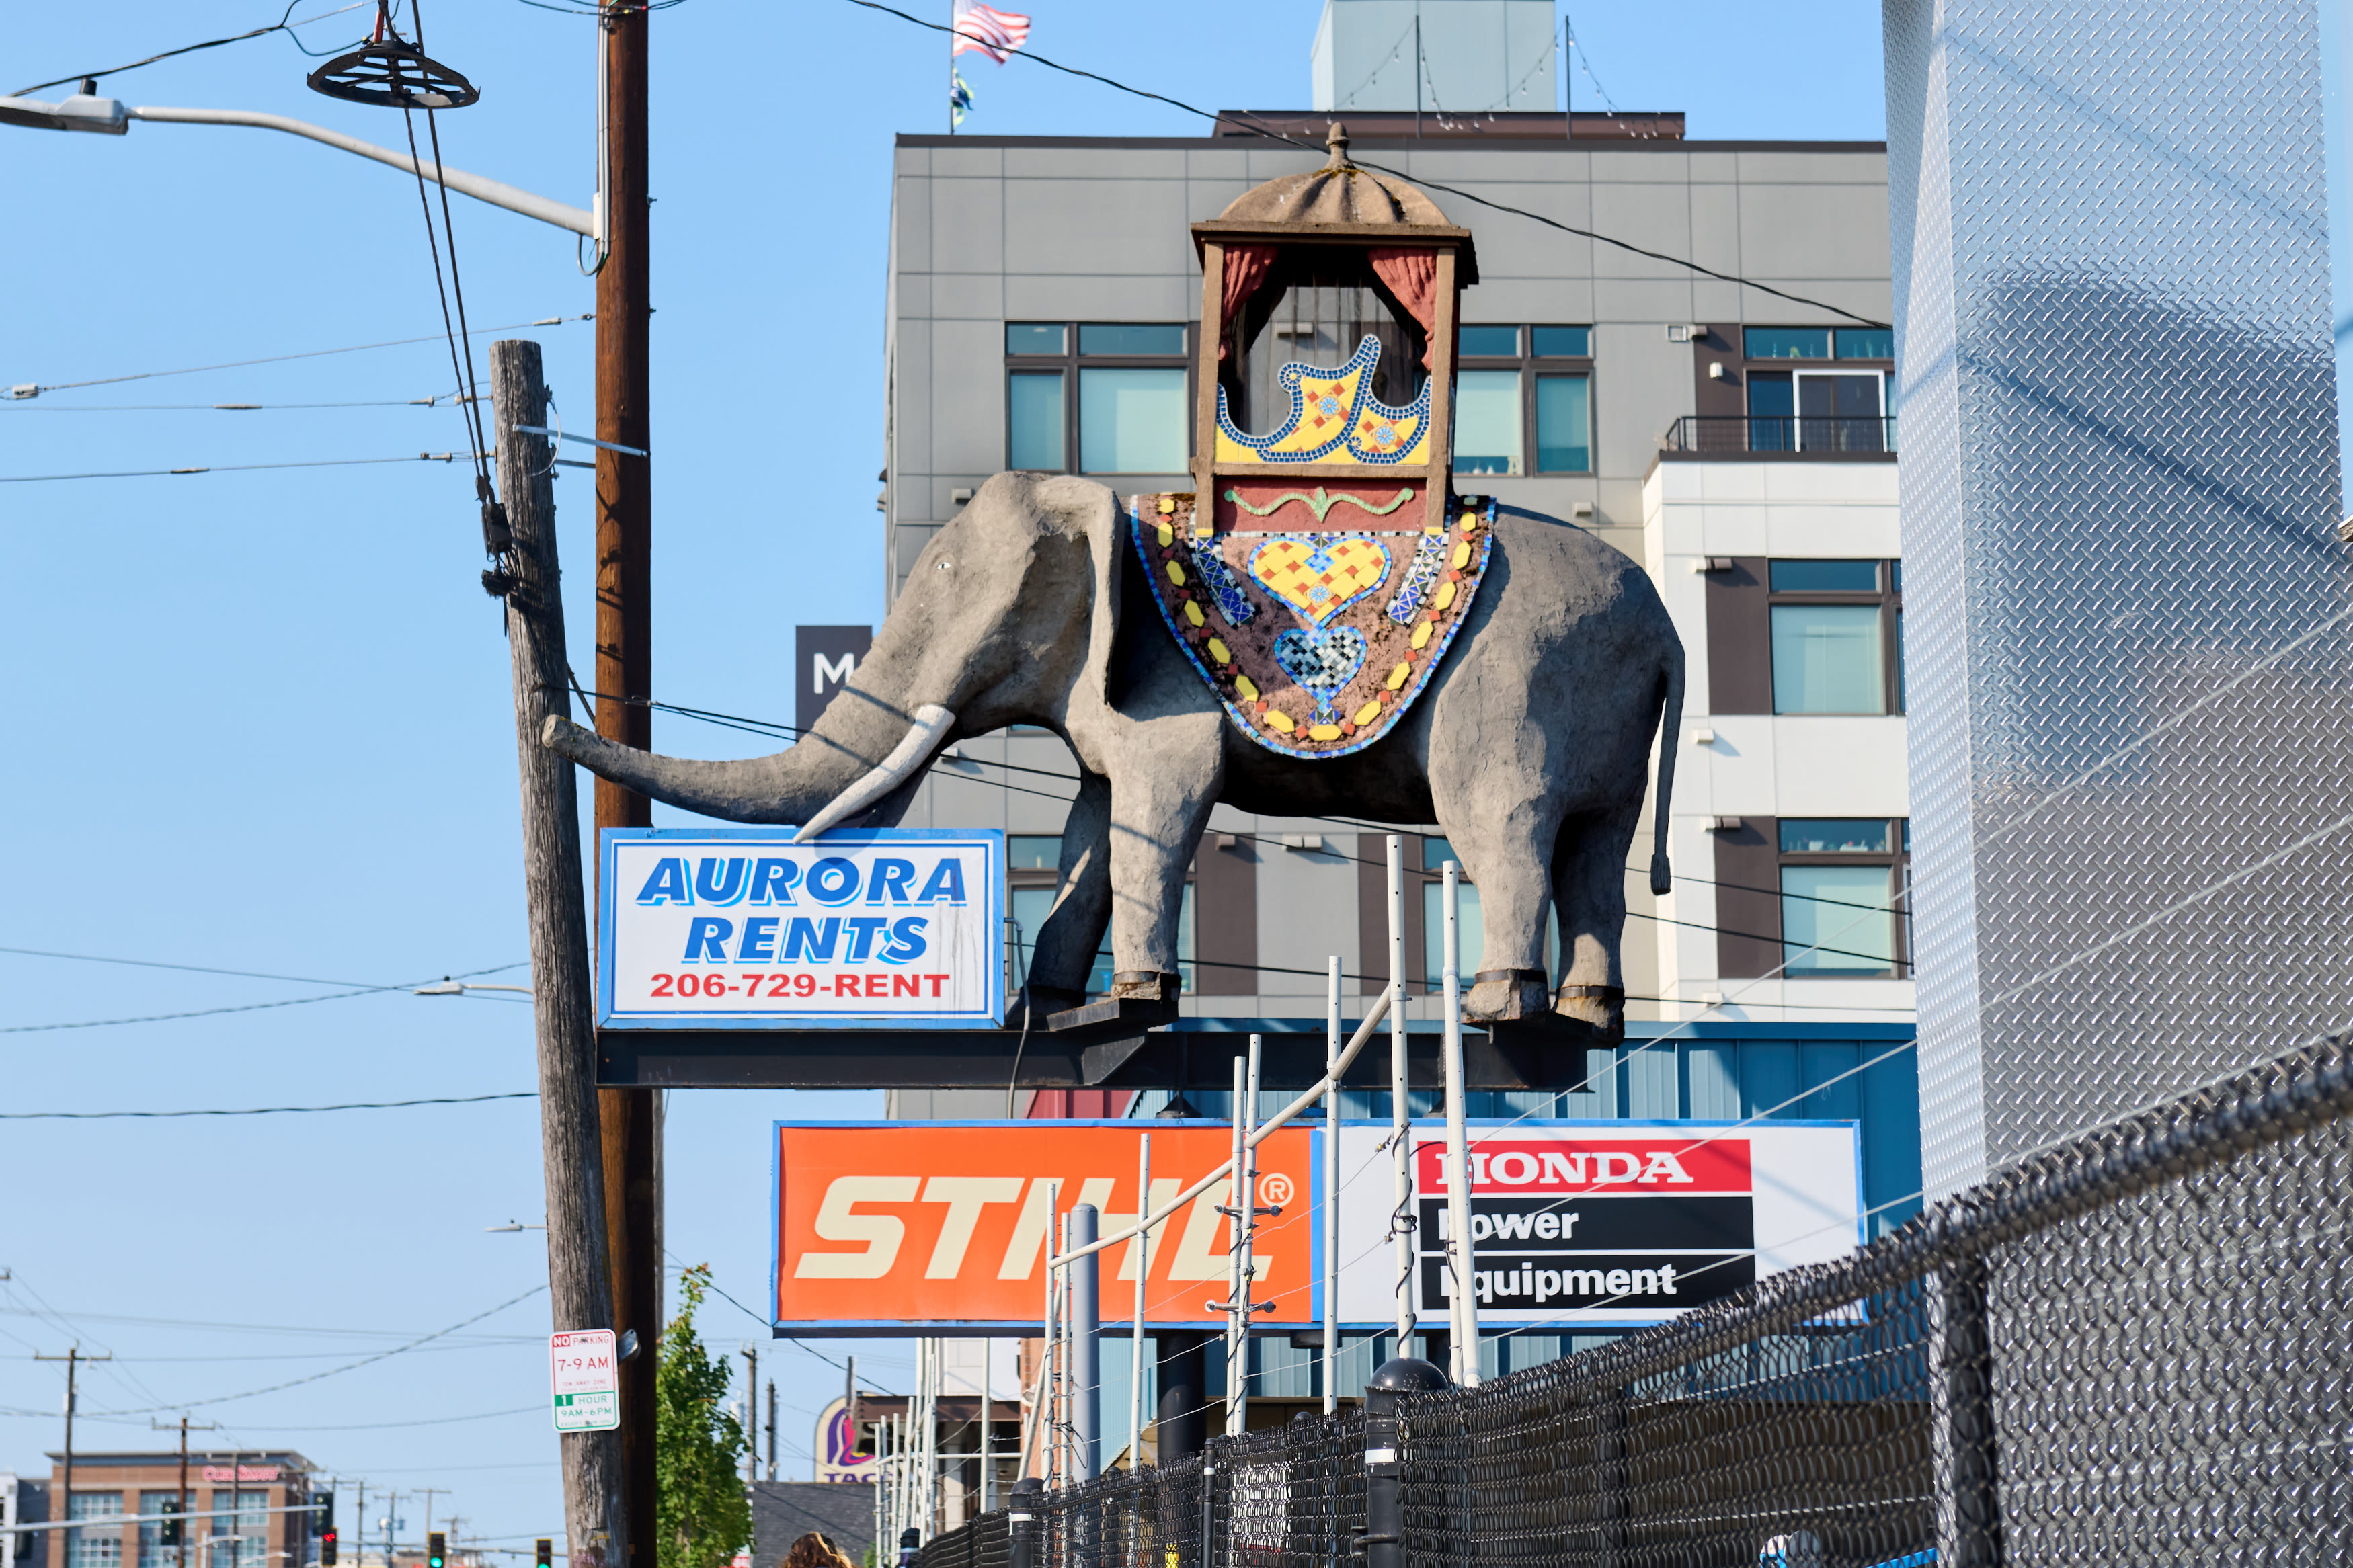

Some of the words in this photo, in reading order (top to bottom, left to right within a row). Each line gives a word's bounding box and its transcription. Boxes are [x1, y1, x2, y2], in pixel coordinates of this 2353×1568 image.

[635, 857, 967, 907] AURORA
[681, 916, 930, 965] RENTS
[649, 973, 951, 998] 206-729-RENT
[553, 1336, 569, 1346] NO
[573, 1335, 609, 1345] PARKING
[557, 1358, 582, 1372] 7-9
[586, 1356, 608, 1370] AM
[561, 1395, 567, 1406] 1
[579, 1395, 607, 1404] HOUR
